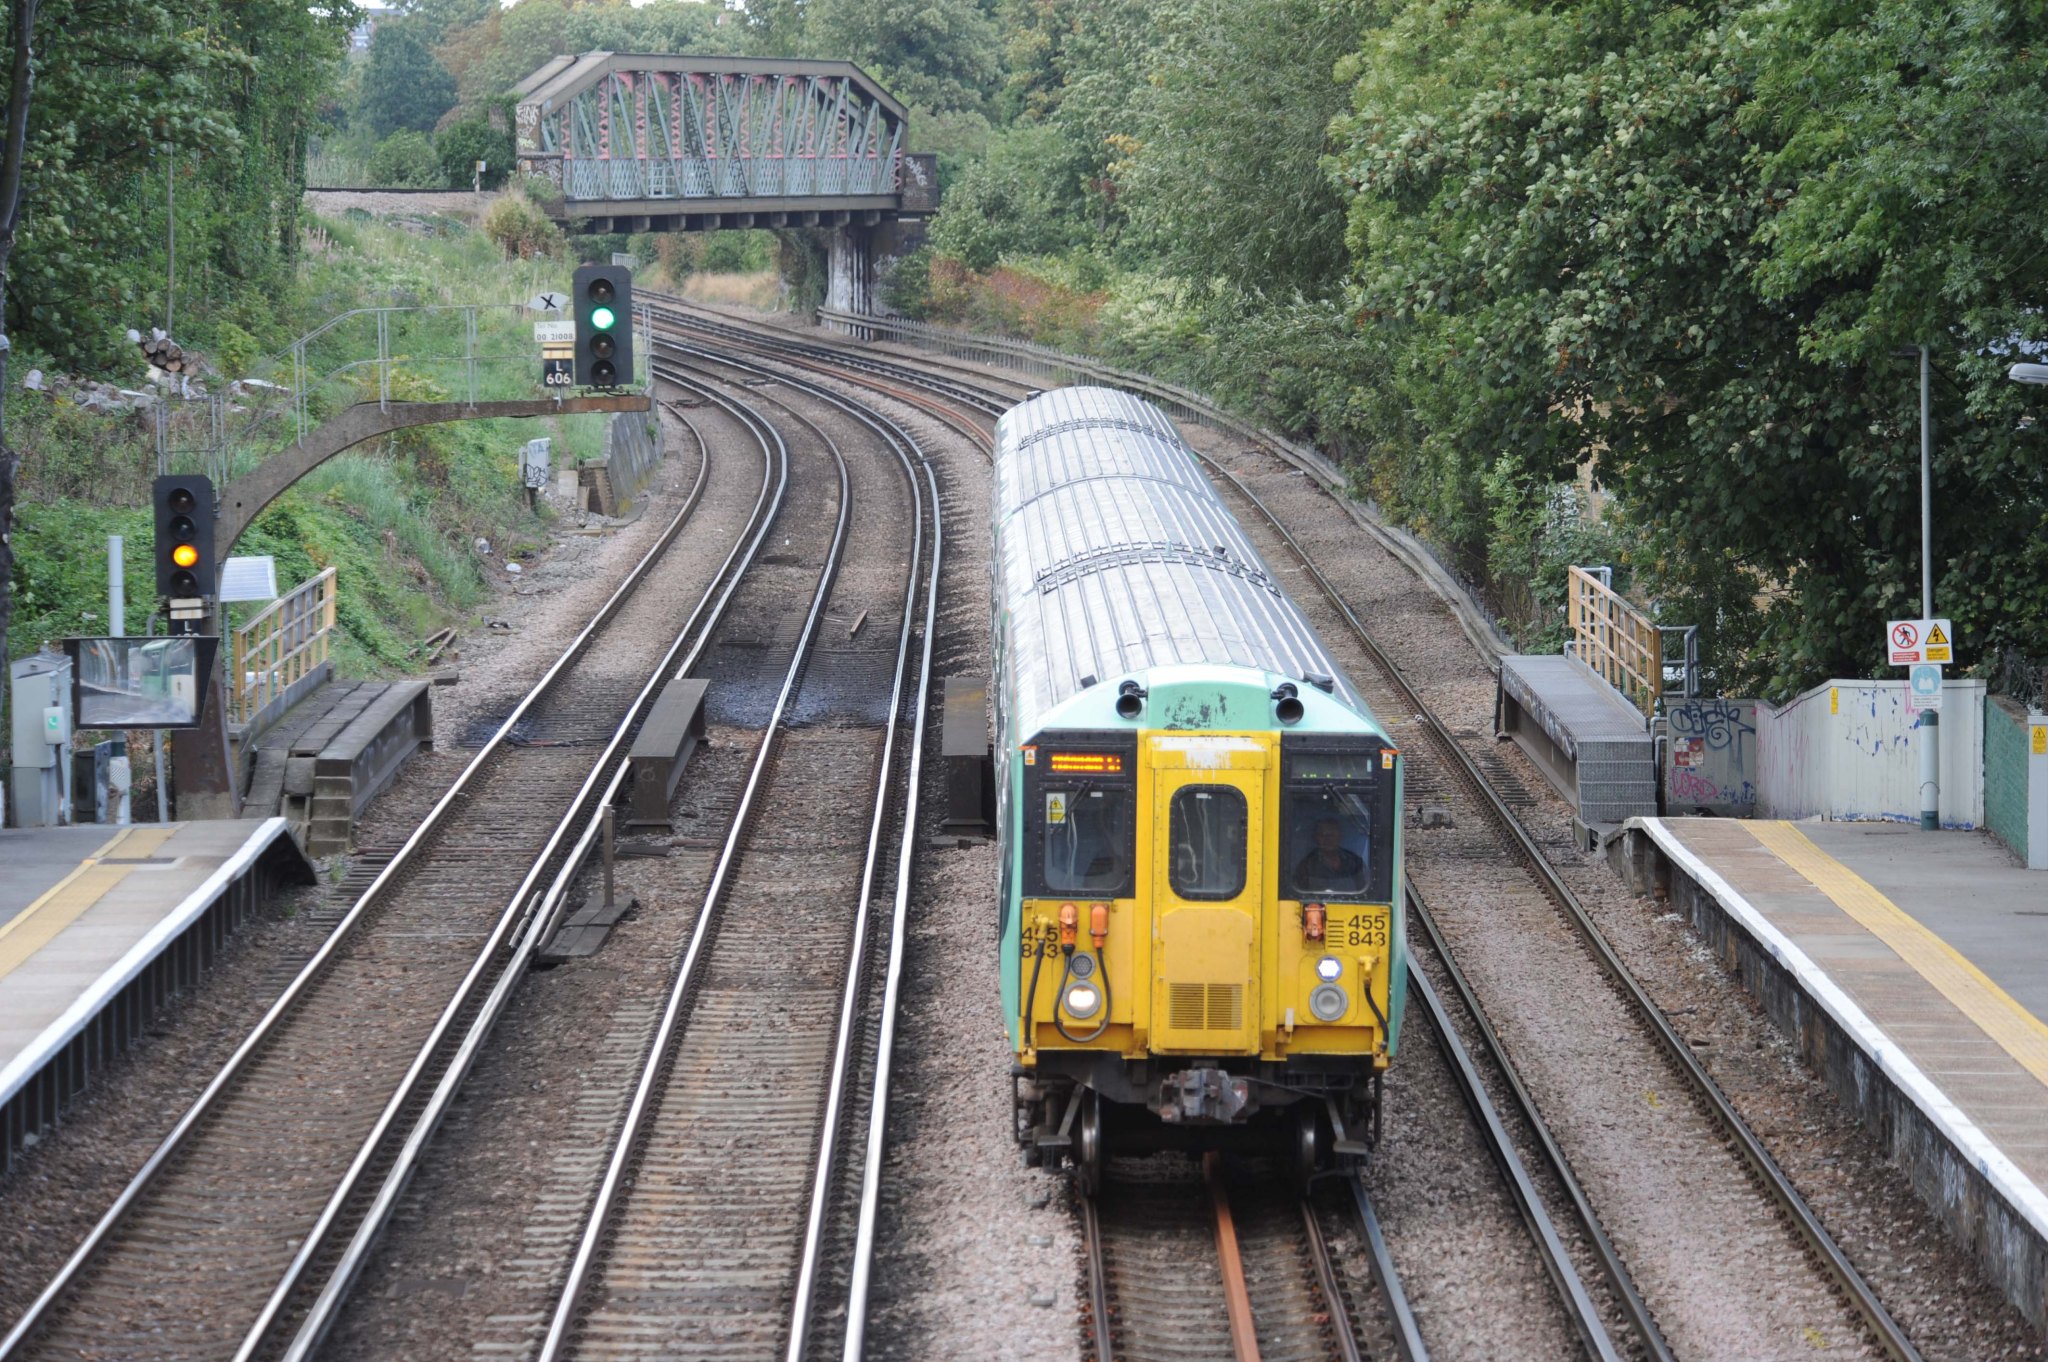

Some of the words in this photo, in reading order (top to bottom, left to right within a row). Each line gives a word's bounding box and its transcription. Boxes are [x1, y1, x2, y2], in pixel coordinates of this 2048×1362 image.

[555, 360, 563, 372] L
[546, 373, 571, 385] 606
[184, 620, 192, 632] L
[1348, 914, 1386, 931] 455
[1348, 930, 1386, 947] 843
[1022, 943, 1058, 959] 83
